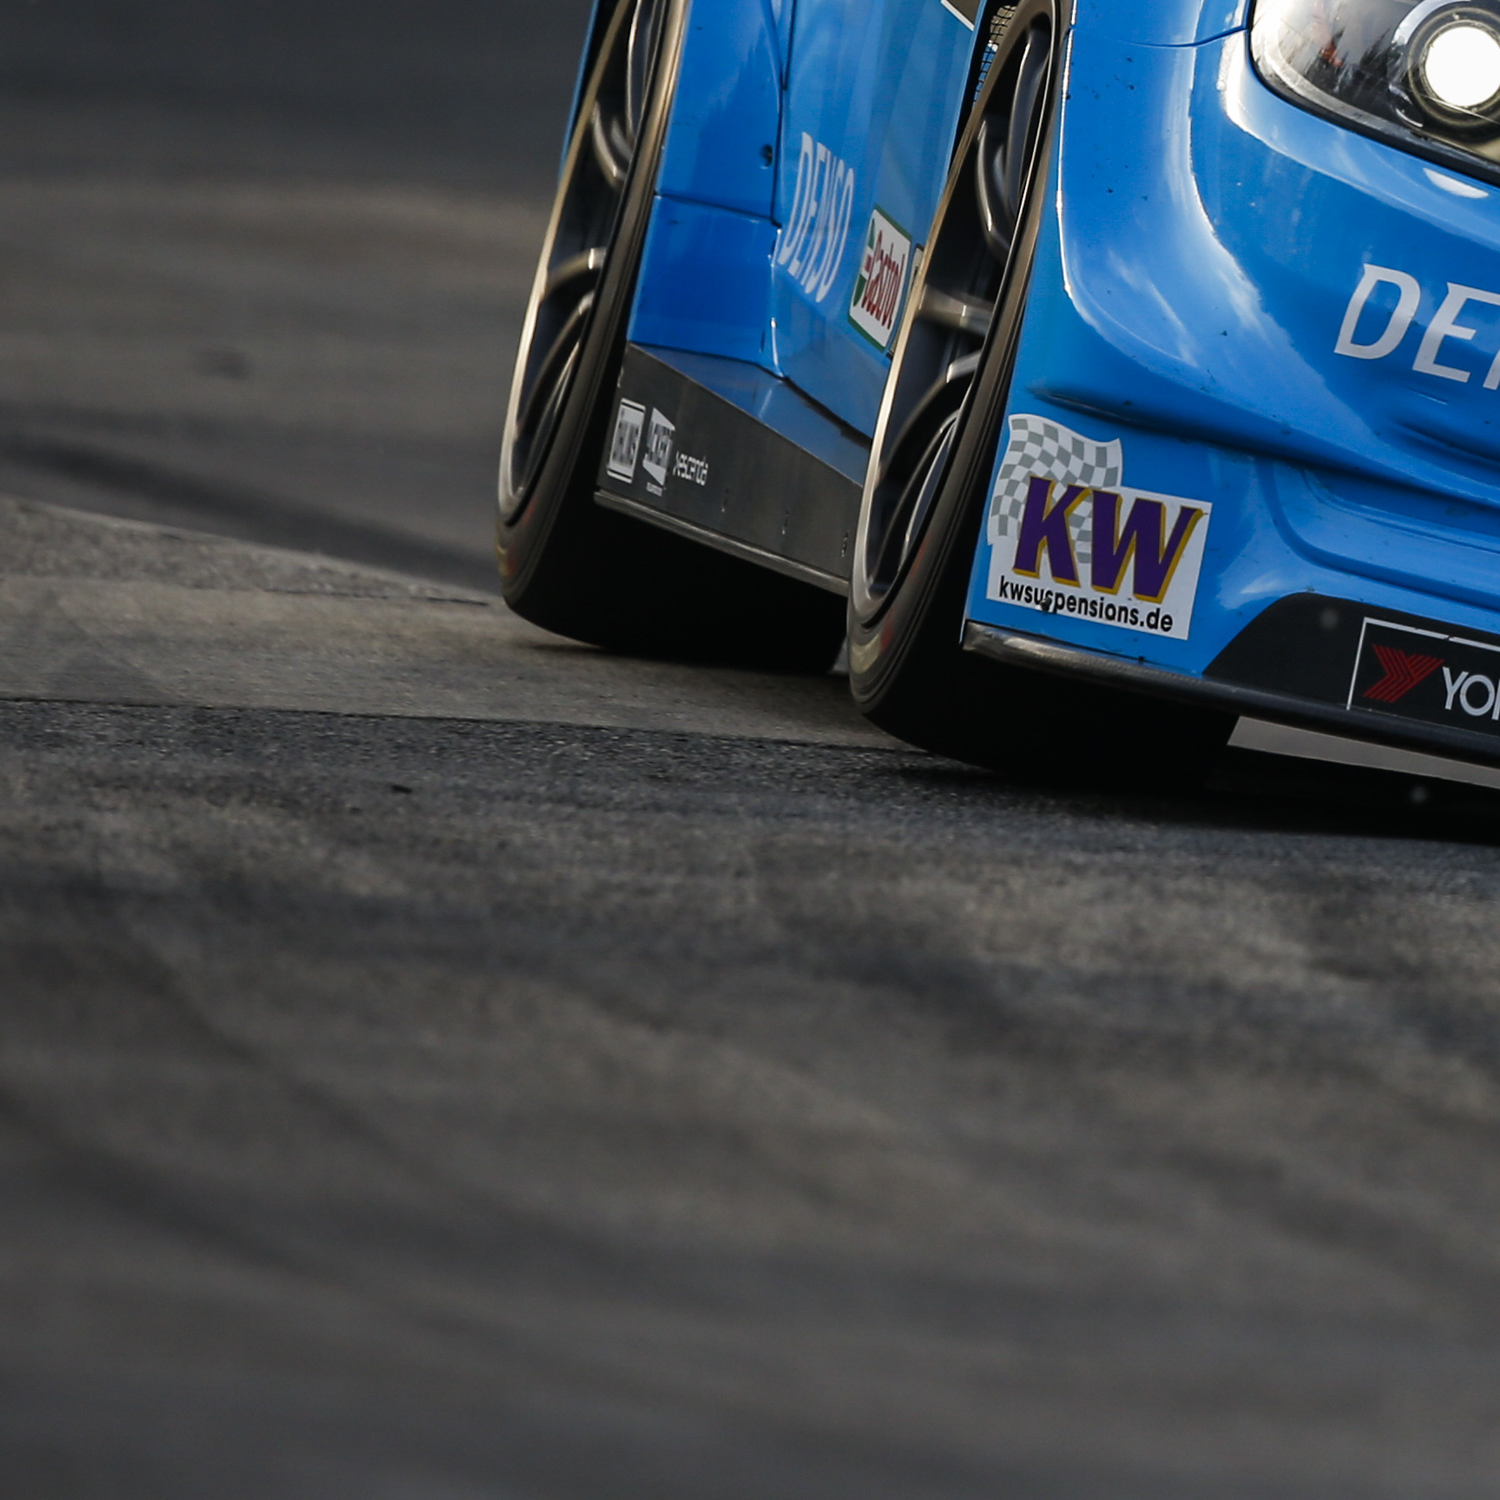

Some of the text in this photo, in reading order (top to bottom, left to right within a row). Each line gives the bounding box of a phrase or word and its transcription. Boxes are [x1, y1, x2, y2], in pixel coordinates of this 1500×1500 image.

[777, 131, 855, 303] DENSO
[999, 575, 1173, 632] kwsuspensions.de
[1012, 475, 1204, 604] KW
